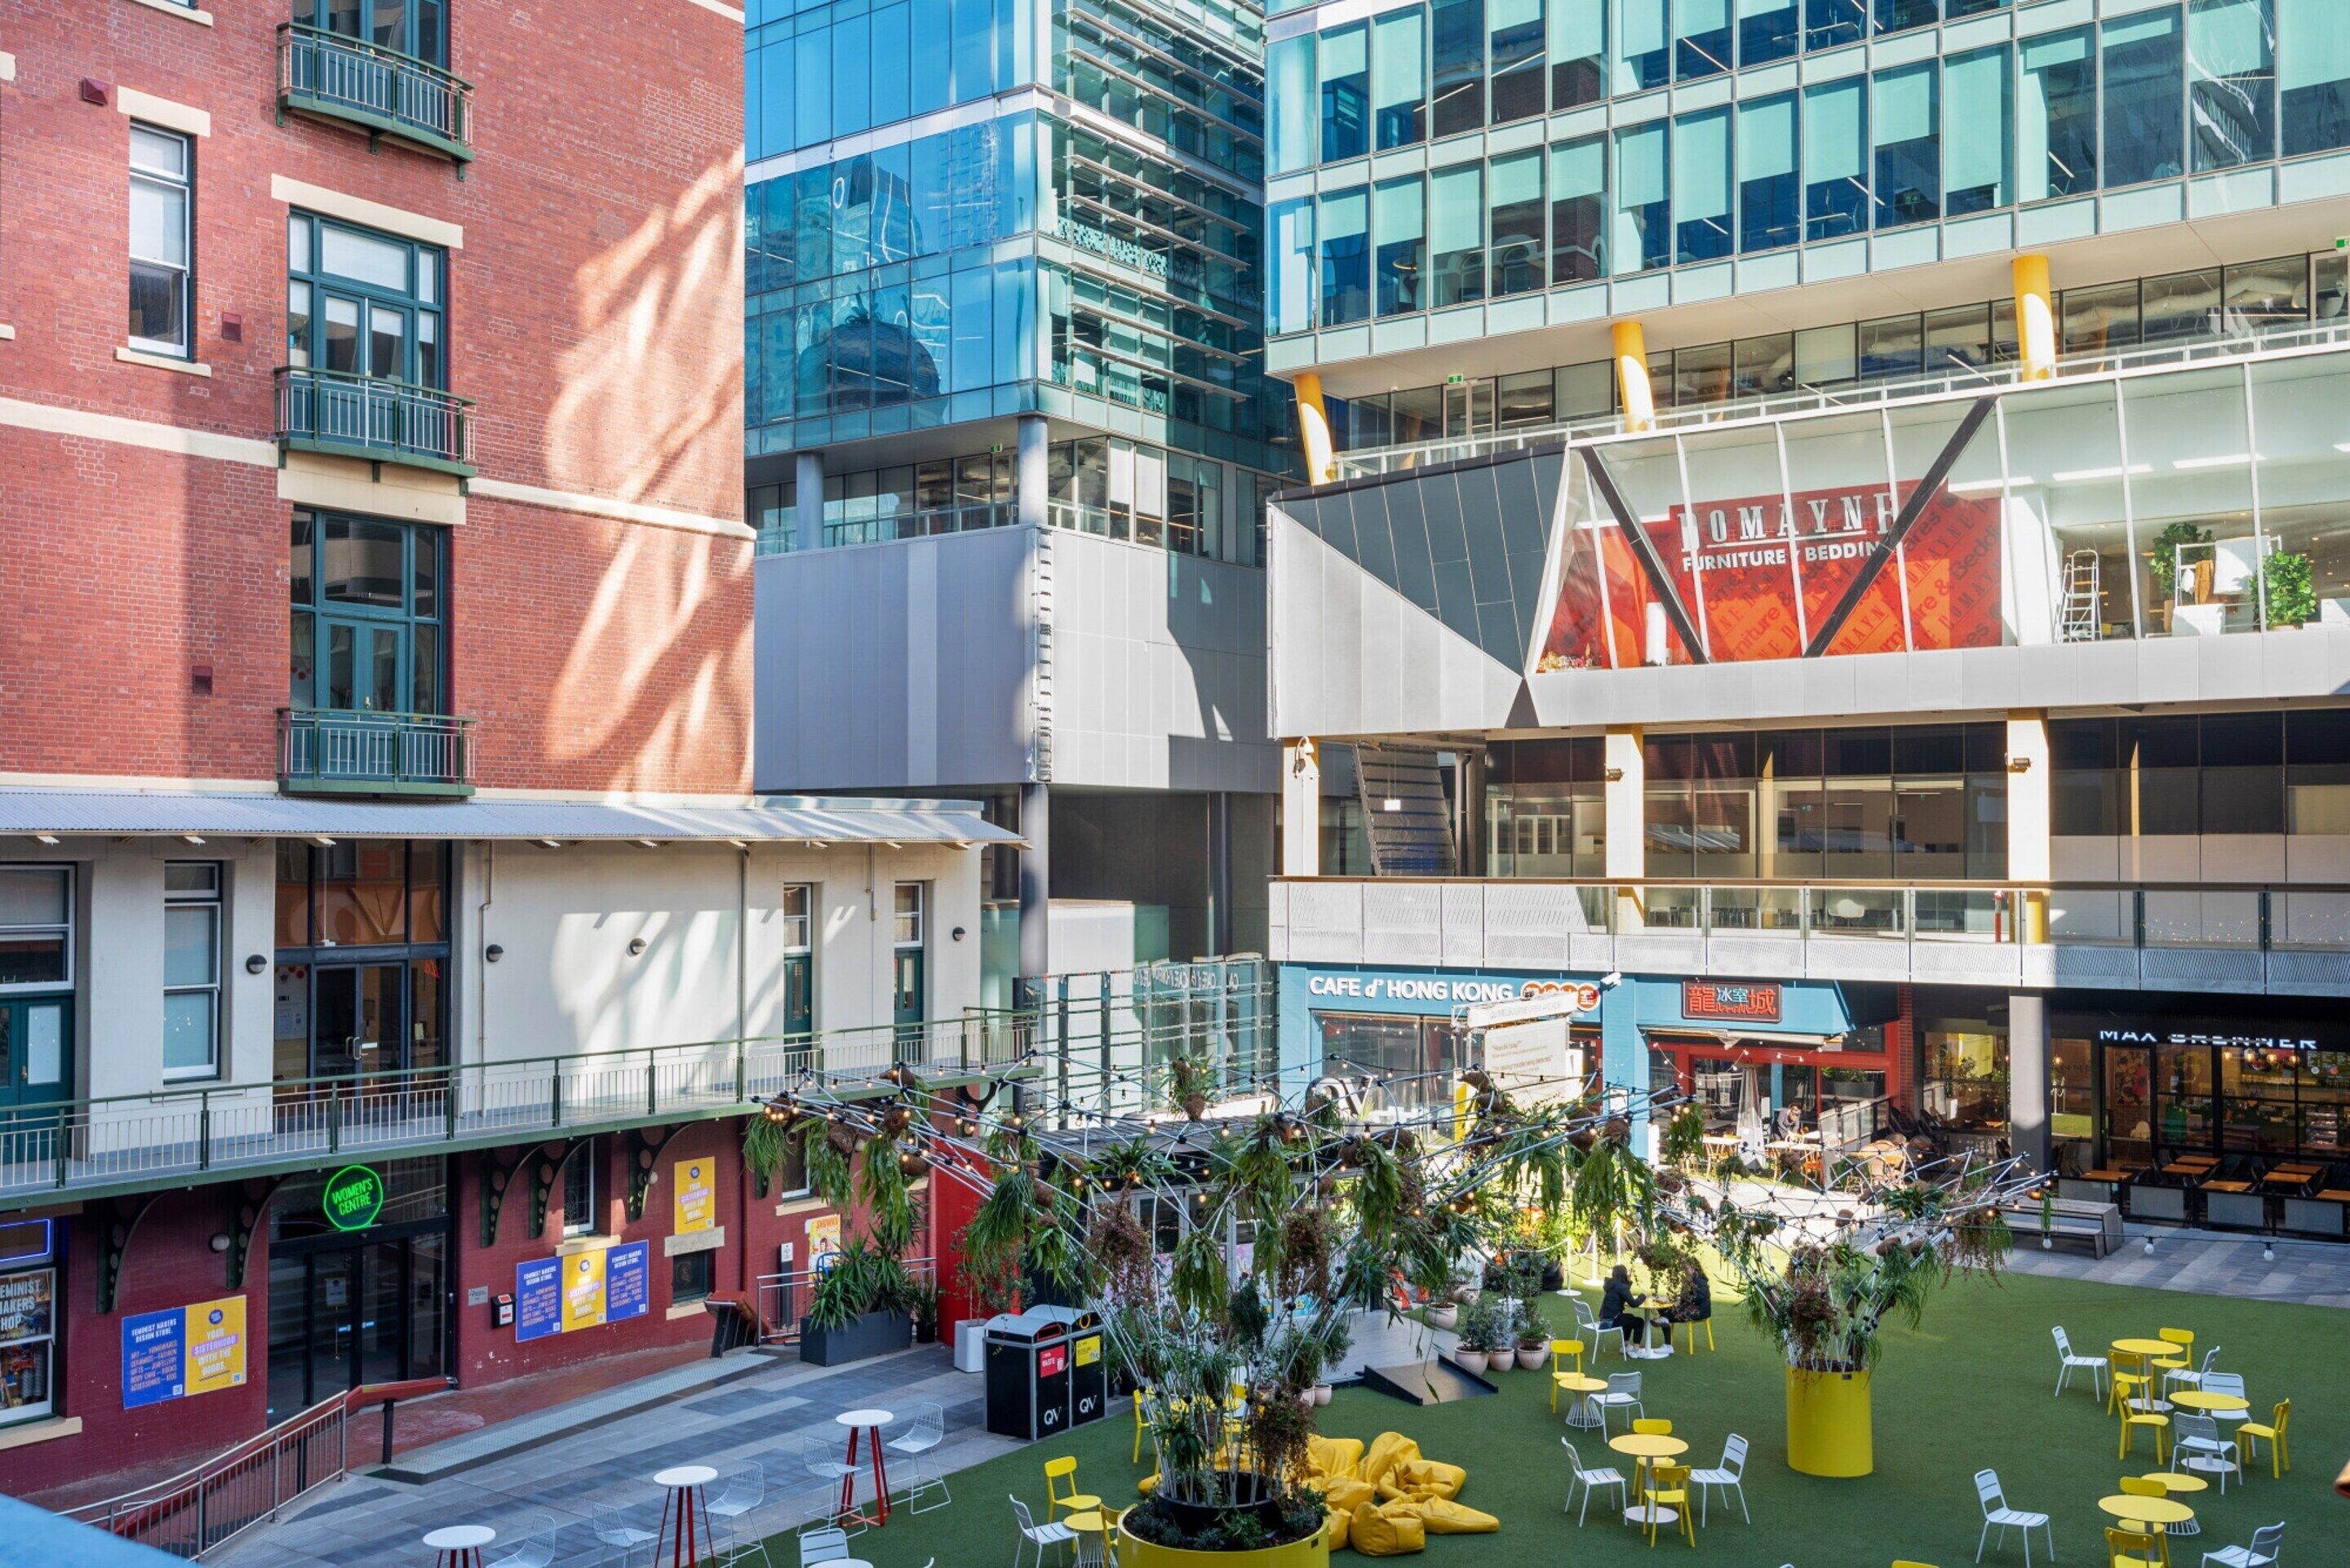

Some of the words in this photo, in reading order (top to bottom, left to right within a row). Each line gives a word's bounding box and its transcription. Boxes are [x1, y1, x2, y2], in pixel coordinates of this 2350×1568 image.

[1683, 549, 1787, 572] FURNITURE
[1805, 541, 1880, 562] BEDDIN
[1309, 977, 1362, 997] CAFE
[1386, 980, 1448, 1000] HONG
[1451, 981, 1514, 1003] KONG
[331, 1177, 373, 1204] WOMEN'S
[339, 1191, 371, 1215] CENTRE
[0, 1279, 40, 1299] EMINIST
[0, 1312, 22, 1331] HOP
[194, 1335, 236, 1355] SISTERHOOD
[1080, 1395, 1097, 1414] QV
[1044, 1406, 1062, 1425] QV
